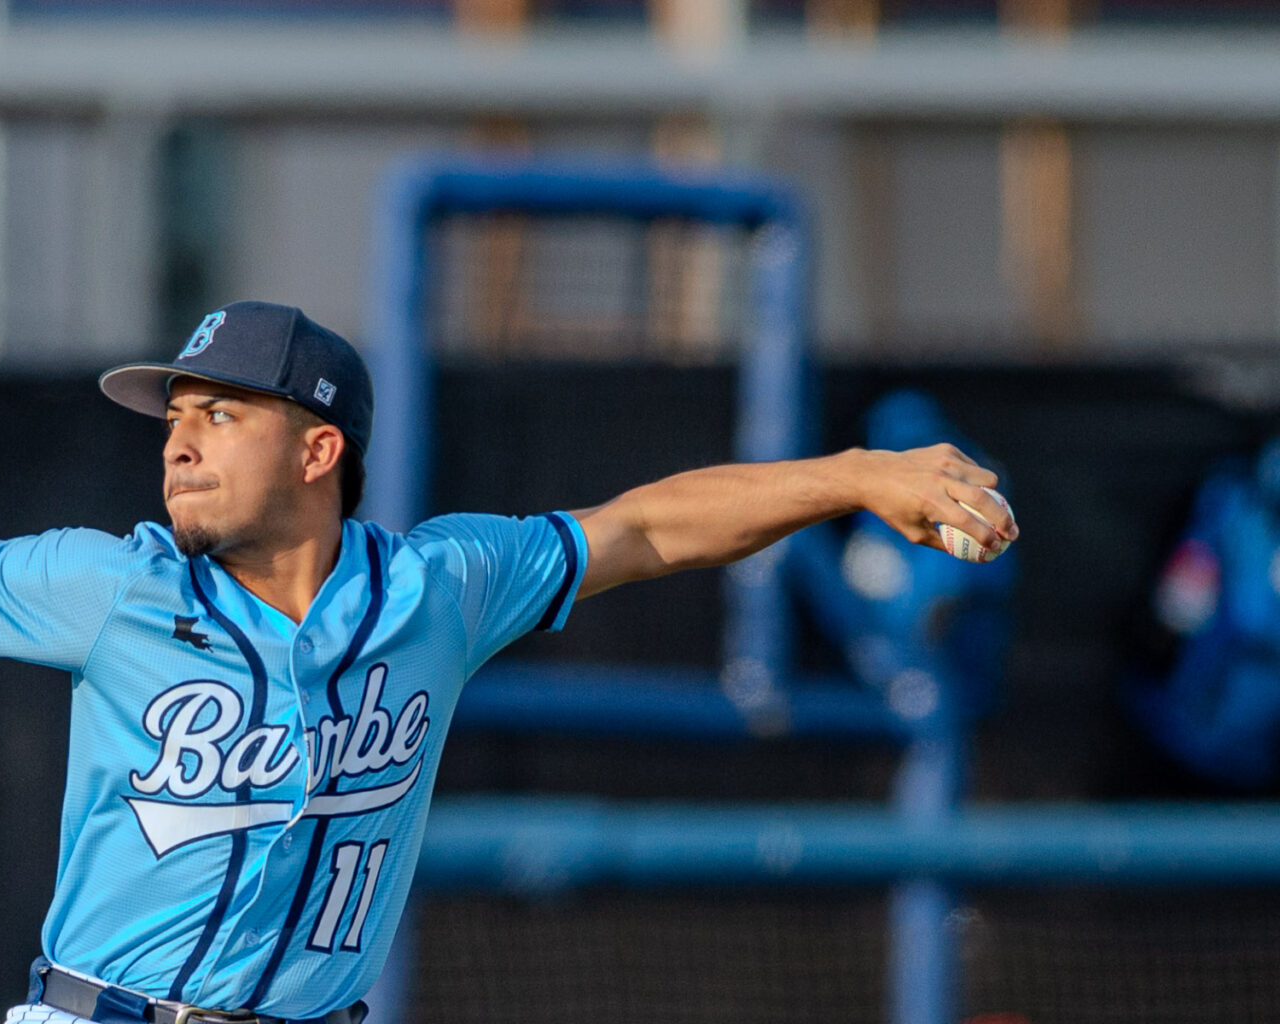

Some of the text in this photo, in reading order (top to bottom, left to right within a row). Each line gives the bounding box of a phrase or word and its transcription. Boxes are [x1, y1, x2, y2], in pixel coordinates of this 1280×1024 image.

[178, 310, 227, 360] B
[129, 662, 430, 799] Barbe
[306, 839, 390, 955] 11
